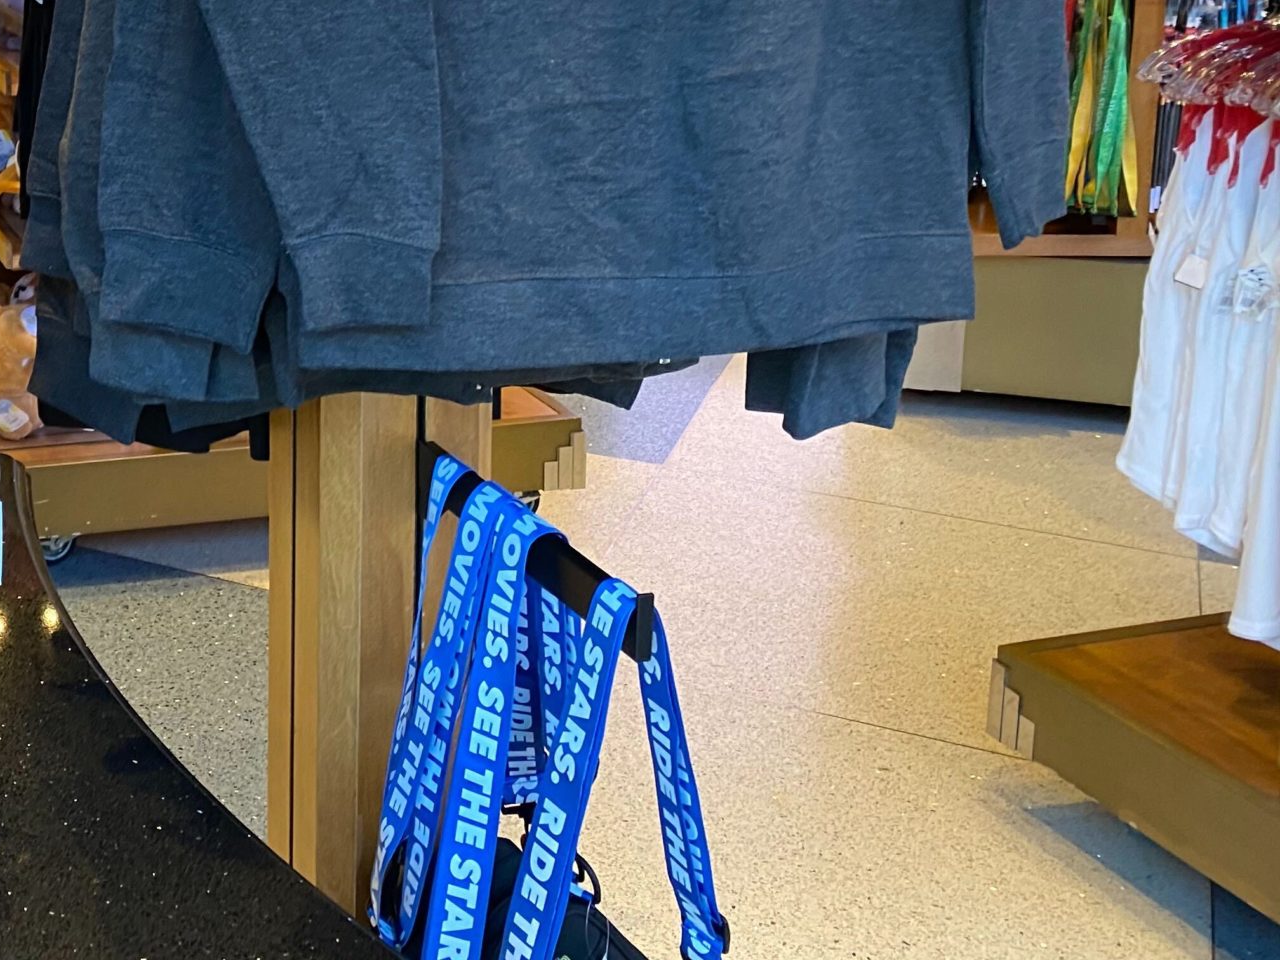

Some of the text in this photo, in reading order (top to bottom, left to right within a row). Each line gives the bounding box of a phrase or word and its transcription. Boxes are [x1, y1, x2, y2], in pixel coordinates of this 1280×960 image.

[435, 486, 503, 647] MOVIES.
[483, 512, 550, 668] MOVIES.
[414, 659, 441, 736] SEE
[469, 680, 505, 762] SEE
[550, 637, 604, 784] STARS.
[389, 741, 423, 818] THE
[455, 768, 494, 850] THE
[648, 697, 678, 806] RIDE
[663, 808, 692, 892] THE
[403, 816, 430, 918] RIDE
[521, 797, 567, 912] RIDE
